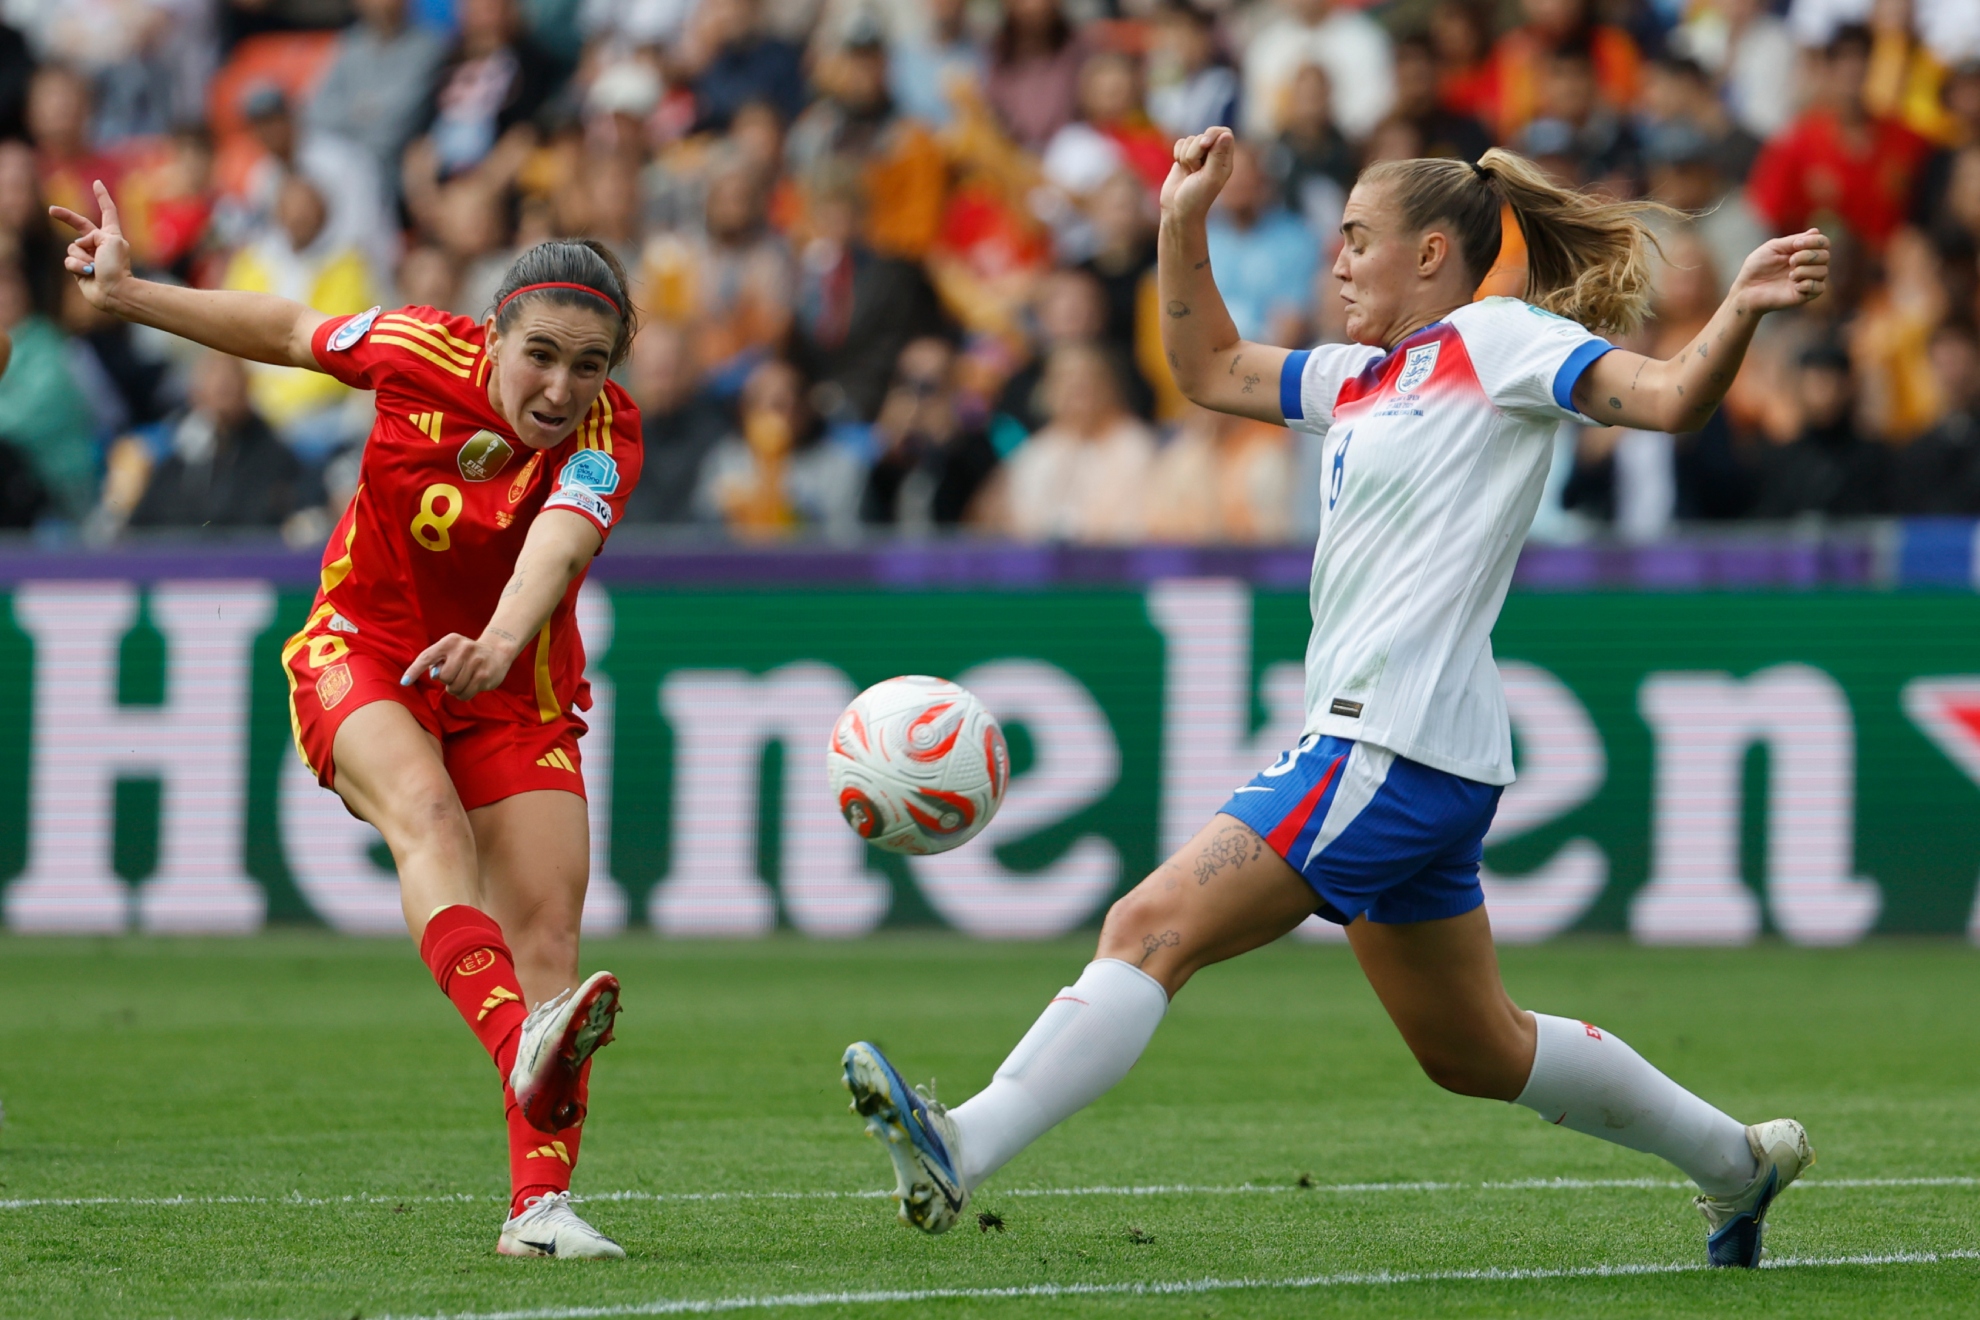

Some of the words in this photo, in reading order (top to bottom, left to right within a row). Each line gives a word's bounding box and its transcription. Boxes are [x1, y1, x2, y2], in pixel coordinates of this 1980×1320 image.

[466, 459, 485, 475] FIFA
[577, 468, 594, 476] play
[1329, 430, 1353, 511] 8
[576, 474, 600, 484] strong
[410, 483, 463, 552] 8
